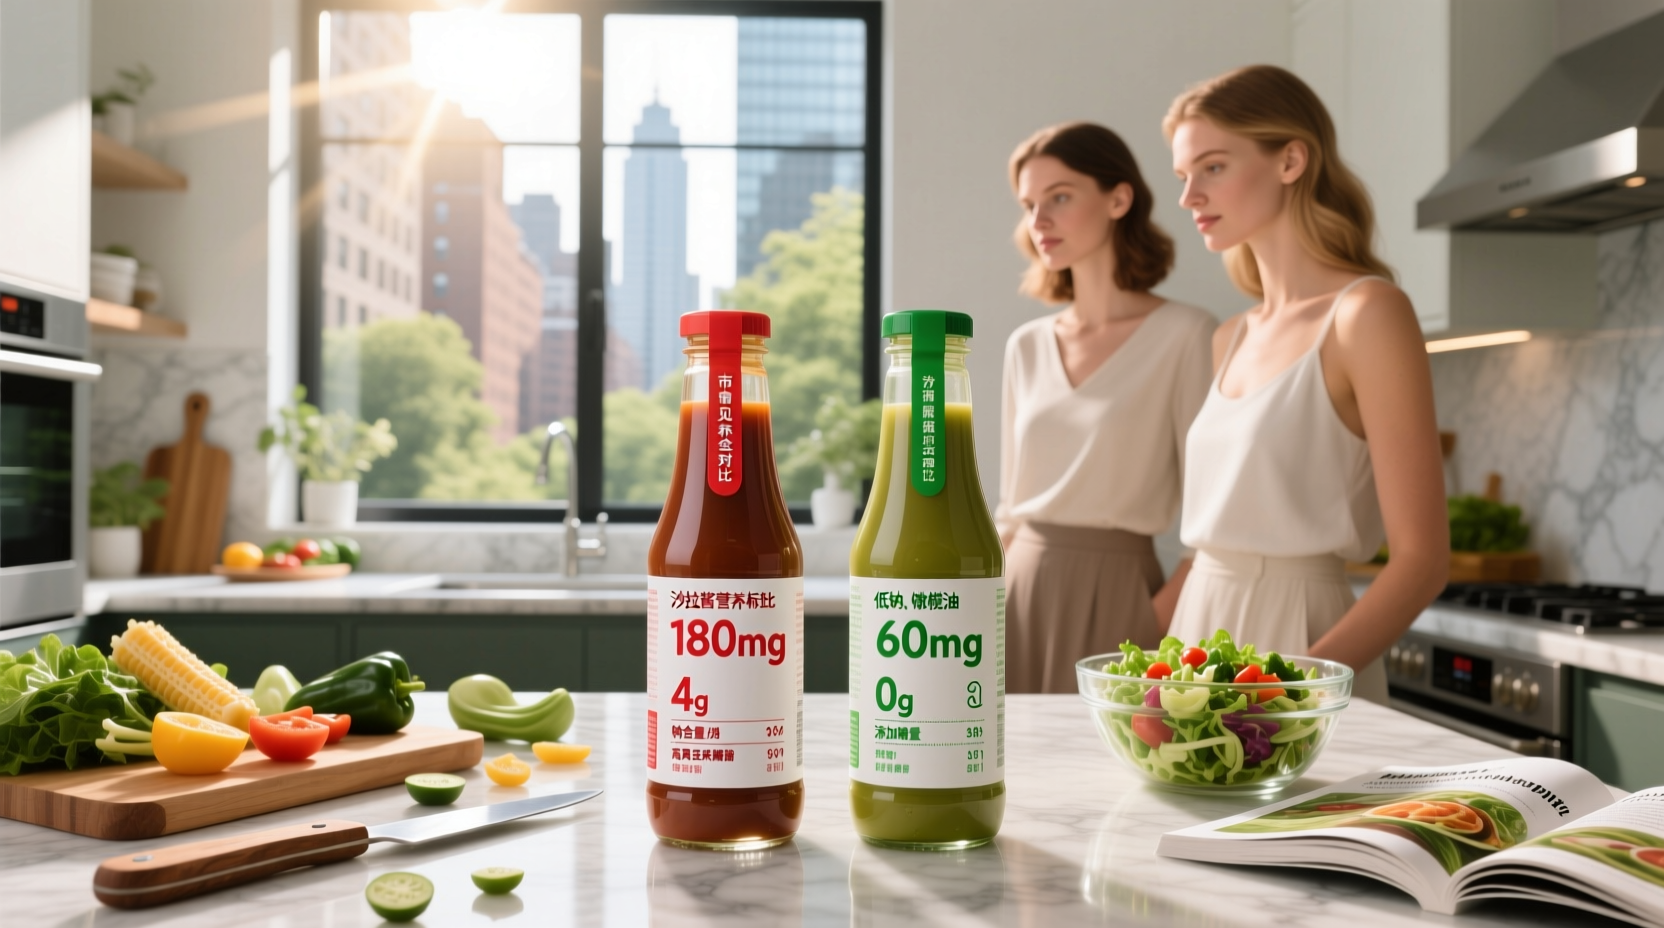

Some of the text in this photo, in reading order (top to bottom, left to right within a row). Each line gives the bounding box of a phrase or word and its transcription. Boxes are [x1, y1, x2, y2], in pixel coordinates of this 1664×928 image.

[670, 618, 786, 666] 180mg
[876, 619, 983, 667] 60mg
[670, 676, 709, 717] 4g
[875, 676, 914, 718] 0g
